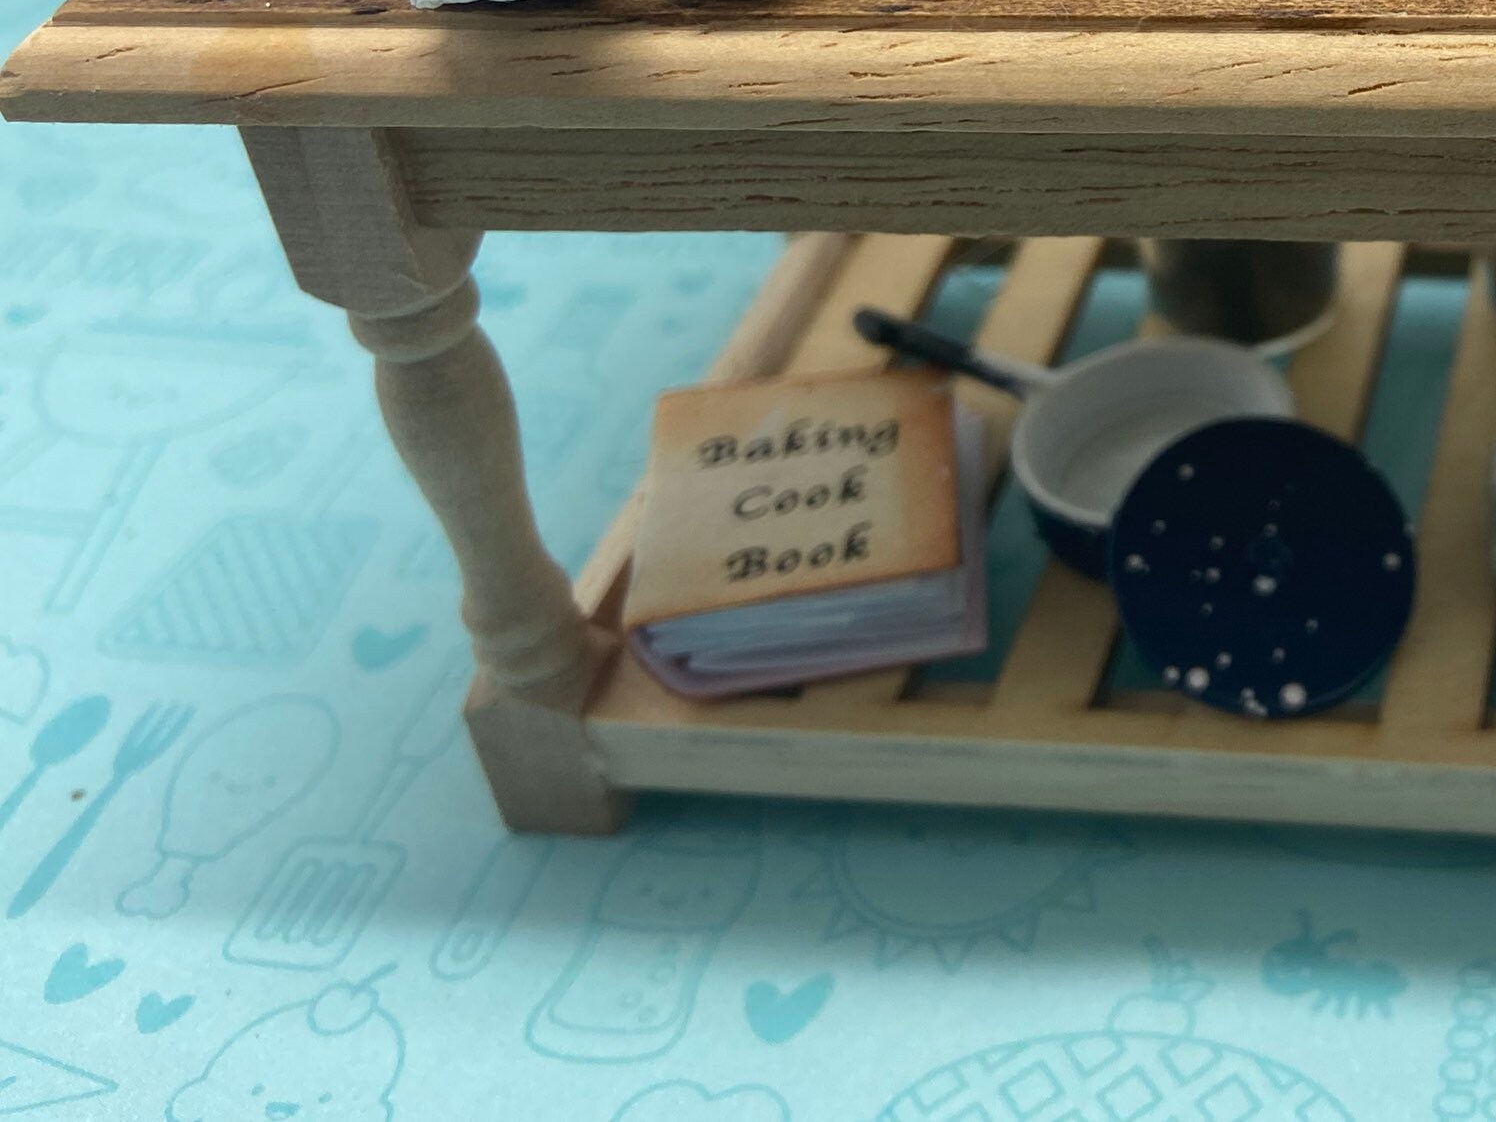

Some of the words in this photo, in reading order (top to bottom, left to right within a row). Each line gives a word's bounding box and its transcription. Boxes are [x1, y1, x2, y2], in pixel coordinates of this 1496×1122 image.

[697, 418, 900, 469] Baking
[733, 464, 869, 521] Cook
[725, 522, 872, 582] Book
